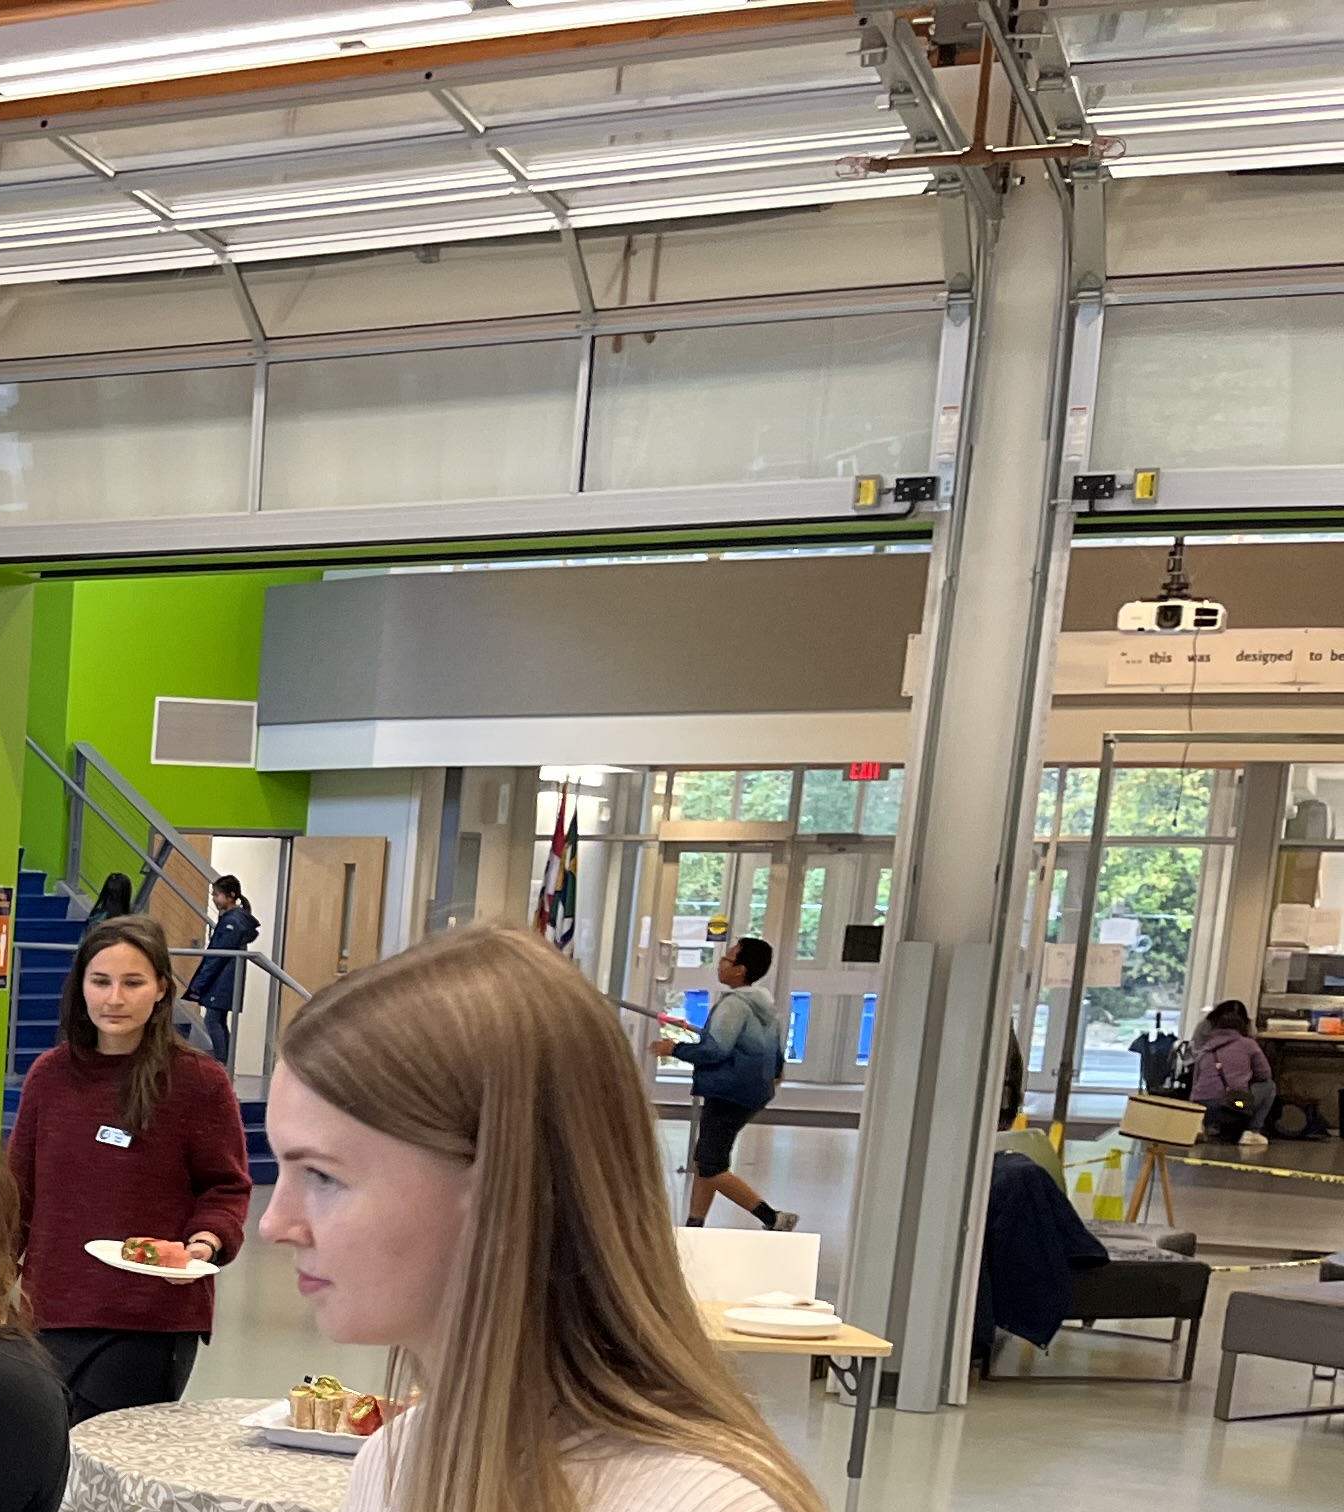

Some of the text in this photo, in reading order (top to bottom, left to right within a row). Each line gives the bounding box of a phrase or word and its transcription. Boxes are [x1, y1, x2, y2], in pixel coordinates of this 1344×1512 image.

[1149, 651, 1172, 664] this
[1187, 654, 1211, 663] was
[1235, 649, 1293, 666] designed
[1309, 651, 1323, 662] to
